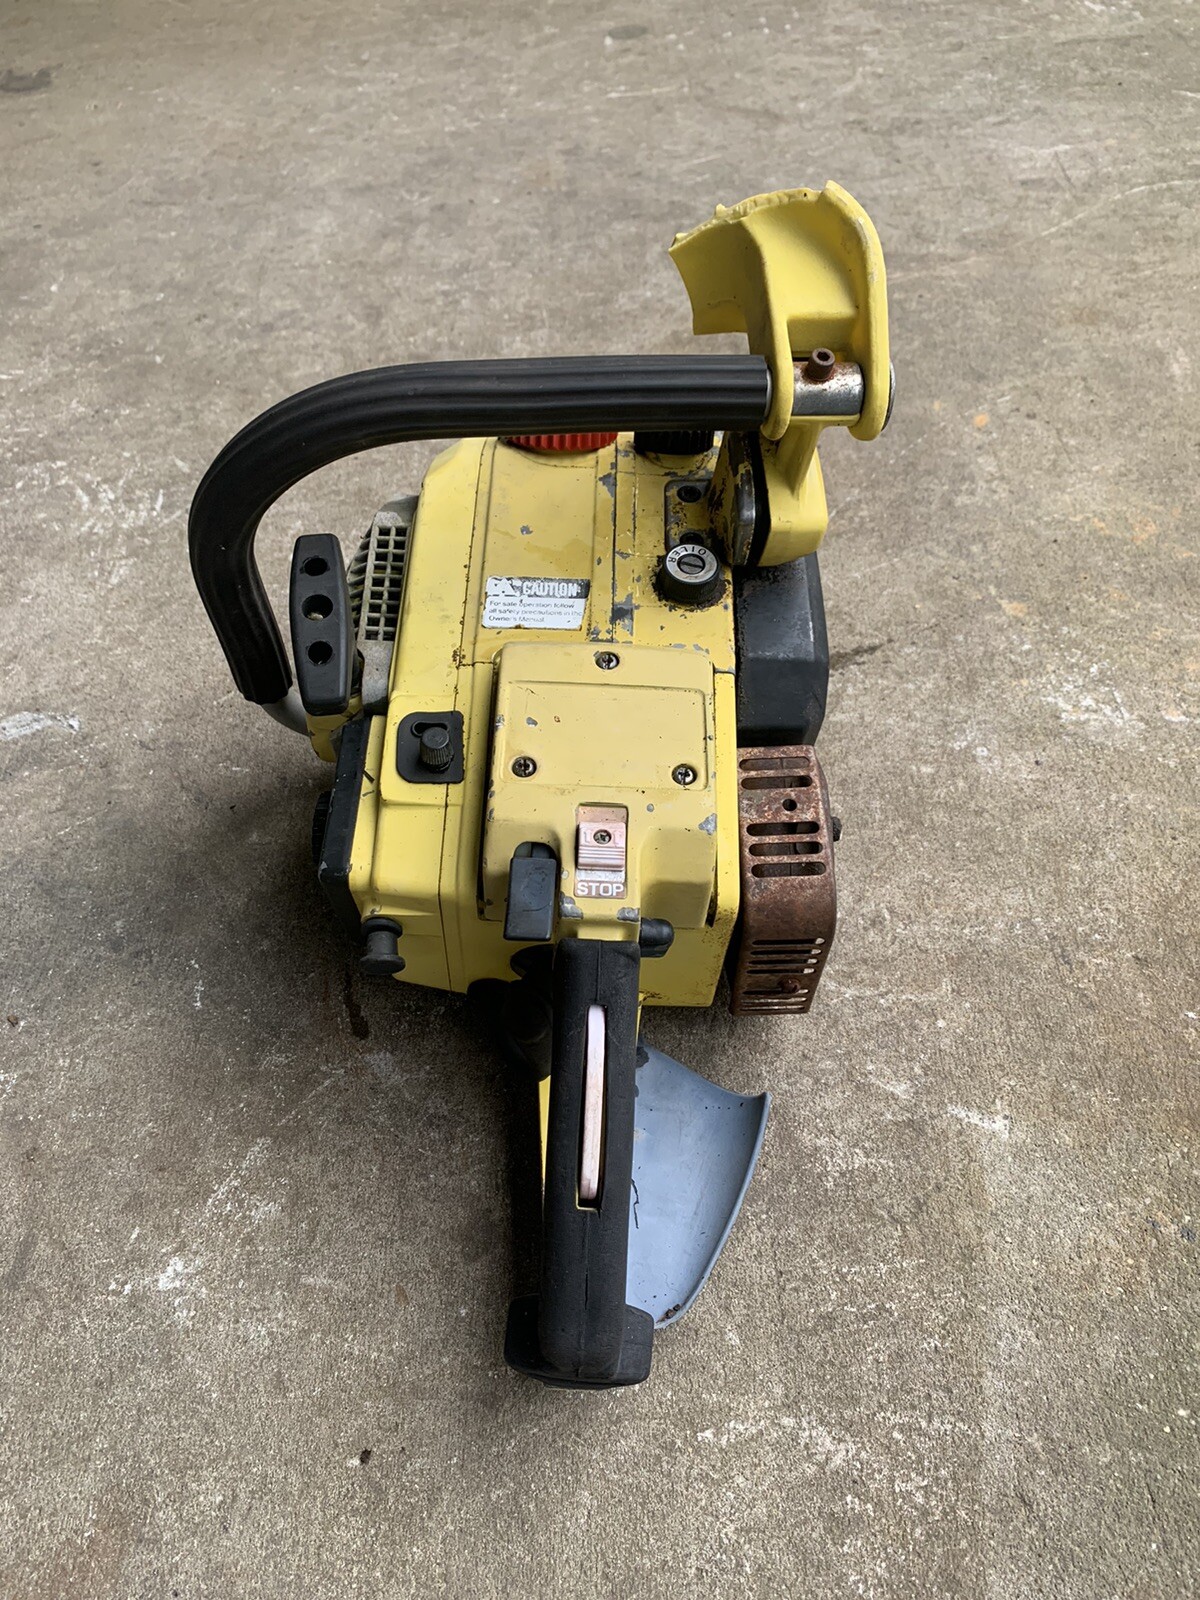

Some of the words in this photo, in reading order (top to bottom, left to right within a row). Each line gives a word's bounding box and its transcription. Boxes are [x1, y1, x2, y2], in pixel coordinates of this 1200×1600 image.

[668, 546, 706, 563] OILER
[522, 581, 578, 597] CAUTION
[577, 882, 624, 896] STOP
